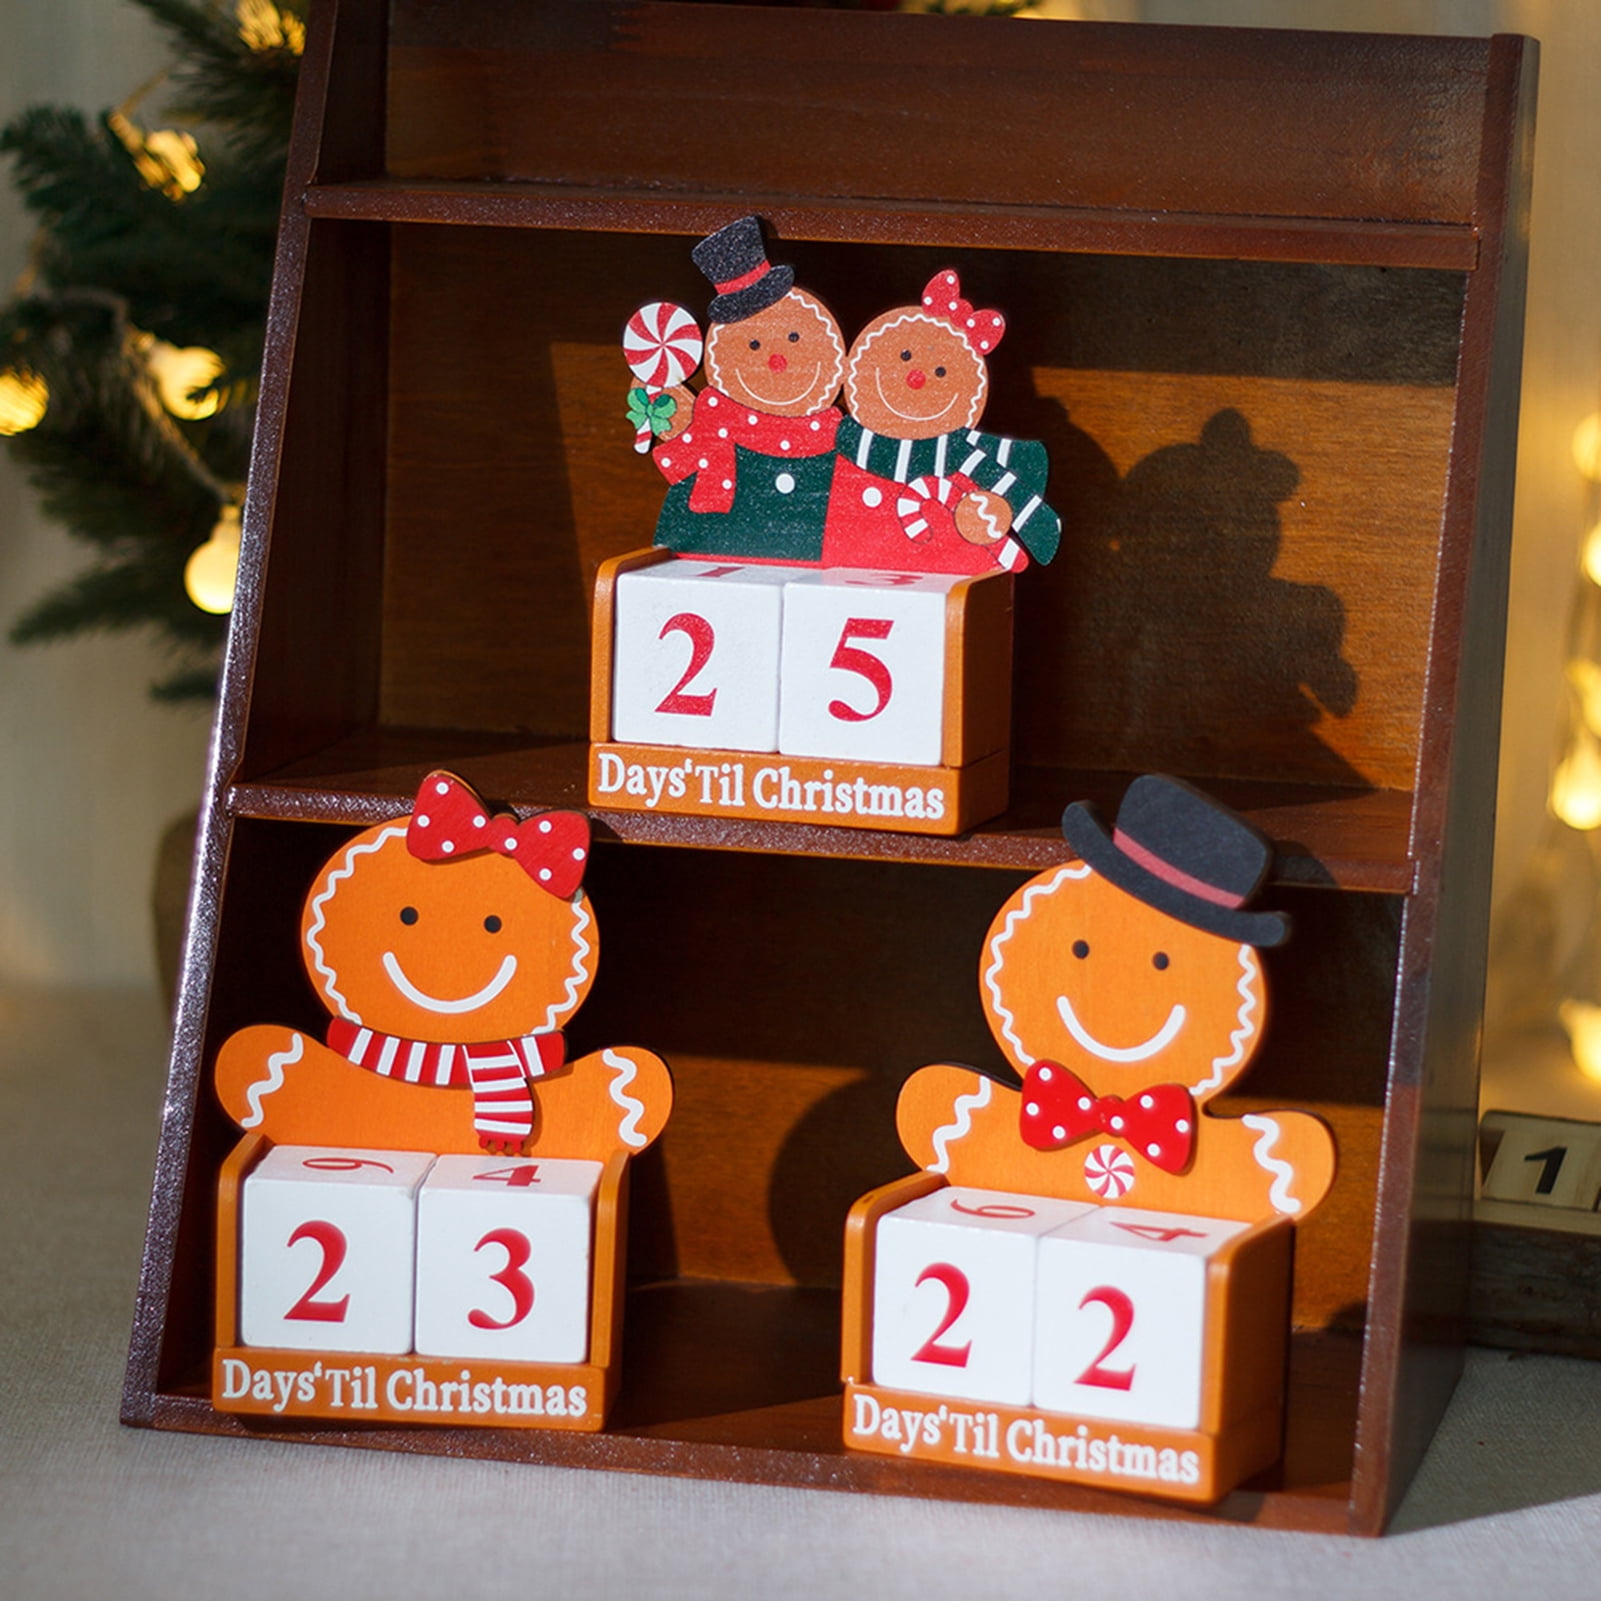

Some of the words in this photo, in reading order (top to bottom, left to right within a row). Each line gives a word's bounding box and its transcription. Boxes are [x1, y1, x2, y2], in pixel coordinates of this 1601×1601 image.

[655, 612, 718, 717] 2
[828, 617, 895, 723] 5
[597, 752, 687, 808] Days
[752, 765, 945, 820] Christmas
[472, 1164, 541, 1187] 4
[1523, 1146, 1569, 1195] 1
[283, 1219, 351, 1323] 2
[467, 1228, 536, 1330] 3
[910, 1261, 973, 1369] 2
[1073, 1284, 1137, 1392] 2
[221, 1358, 318, 1412] Days
[386, 1369, 588, 1418] Christmas
[852, 1393, 941, 1453] Days
[1006, 1418, 1201, 1485] Christmas
